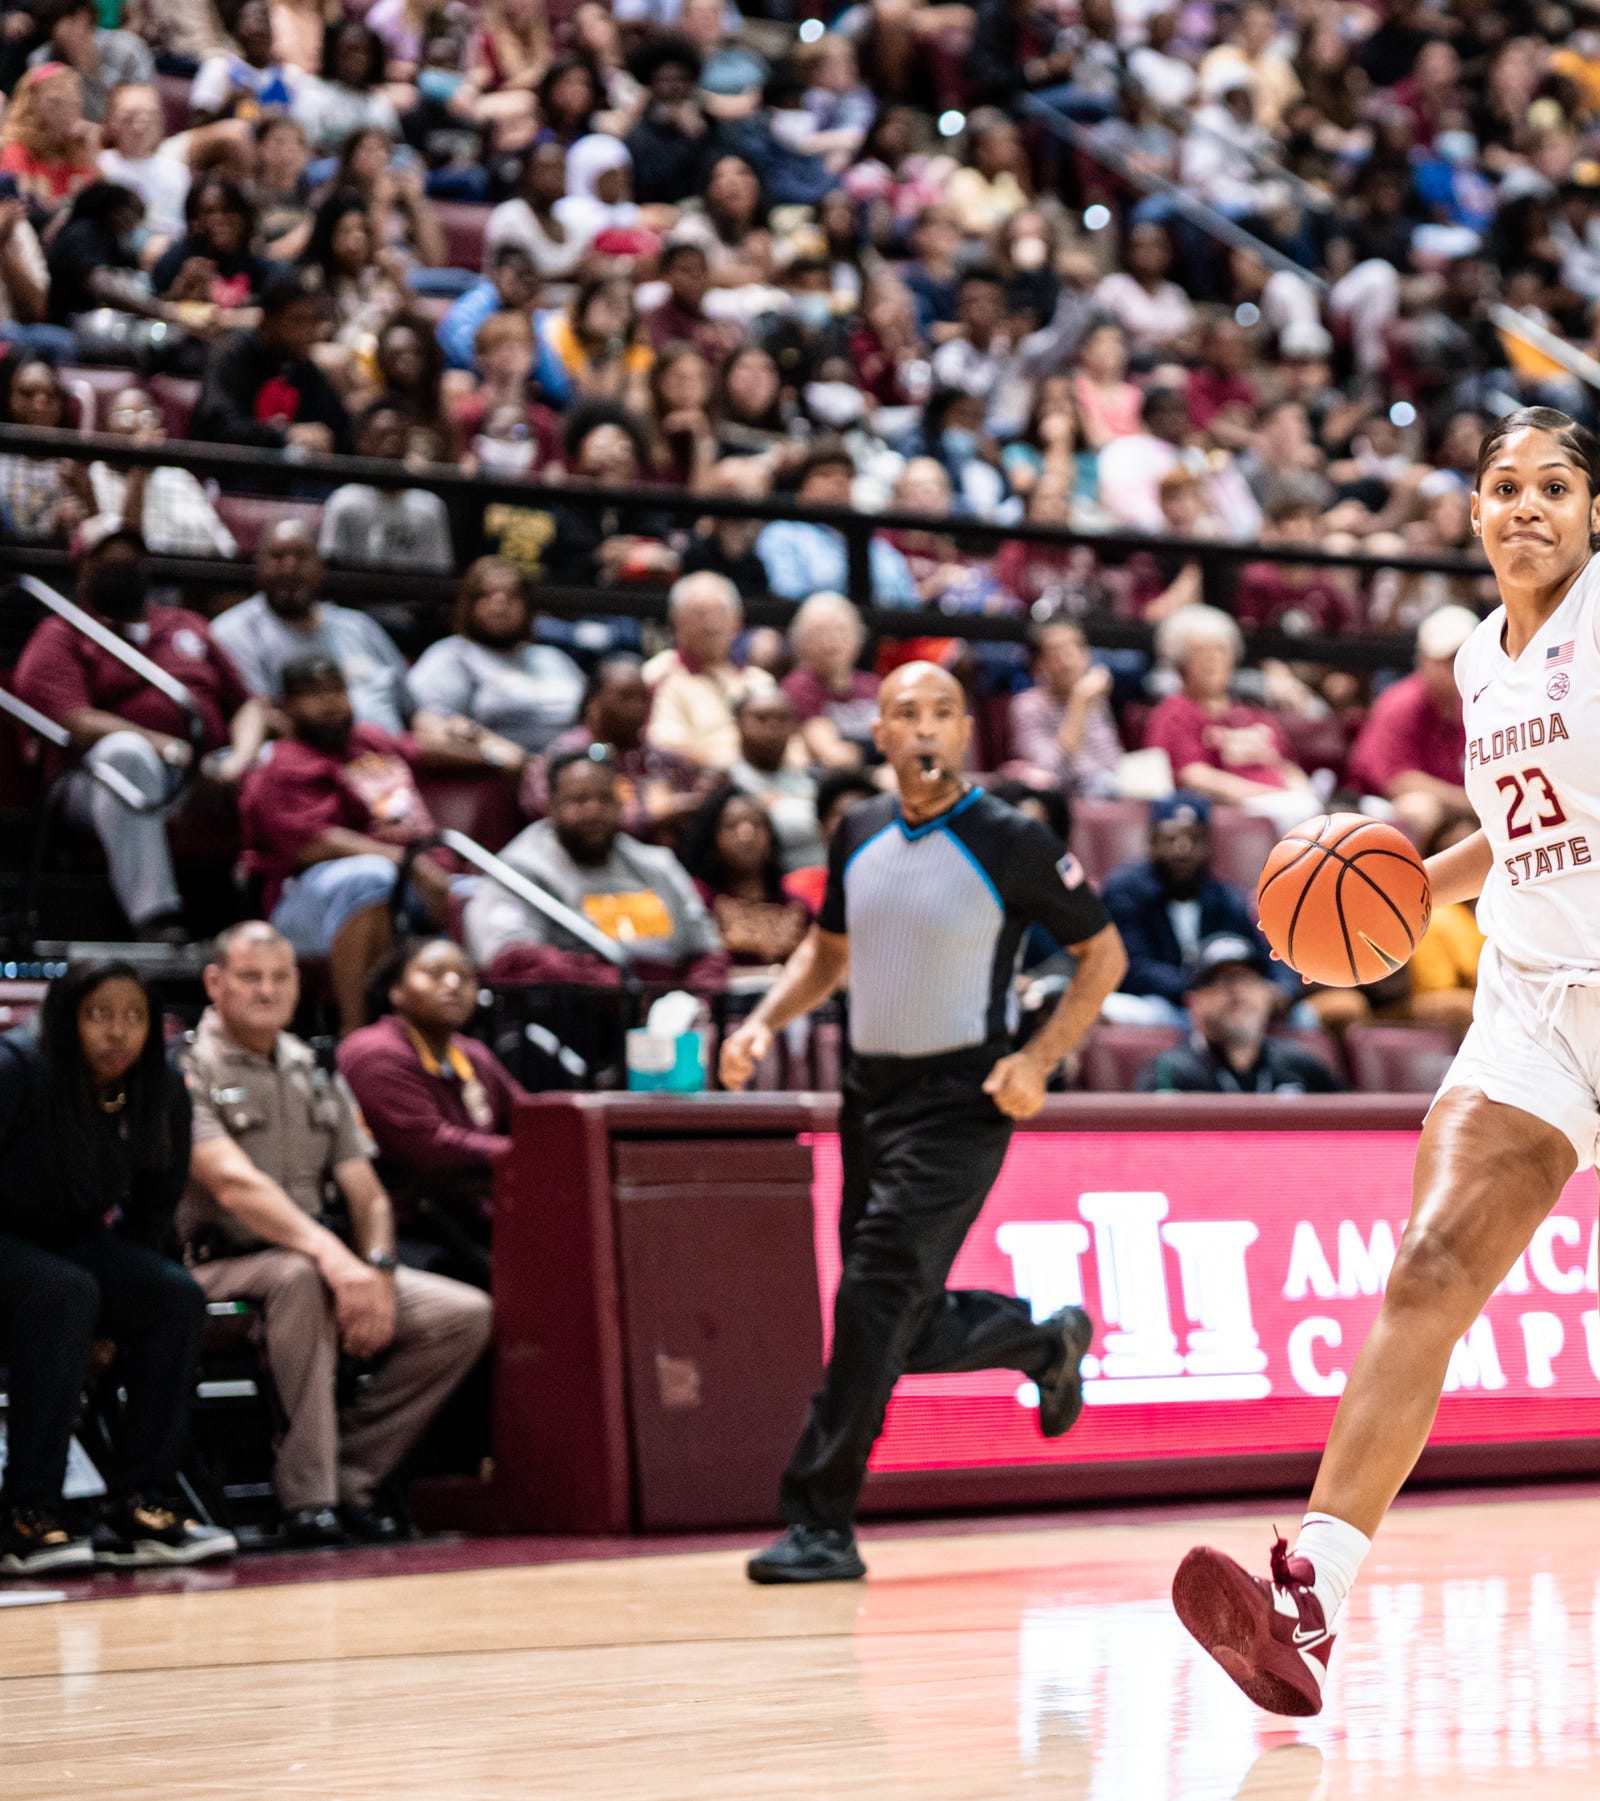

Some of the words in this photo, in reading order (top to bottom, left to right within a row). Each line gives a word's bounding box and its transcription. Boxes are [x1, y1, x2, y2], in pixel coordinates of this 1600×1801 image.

[1469, 712, 1569, 770] FLORIDA
[1495, 767, 1568, 840] 23
[1505, 836, 1592, 886] STATE
